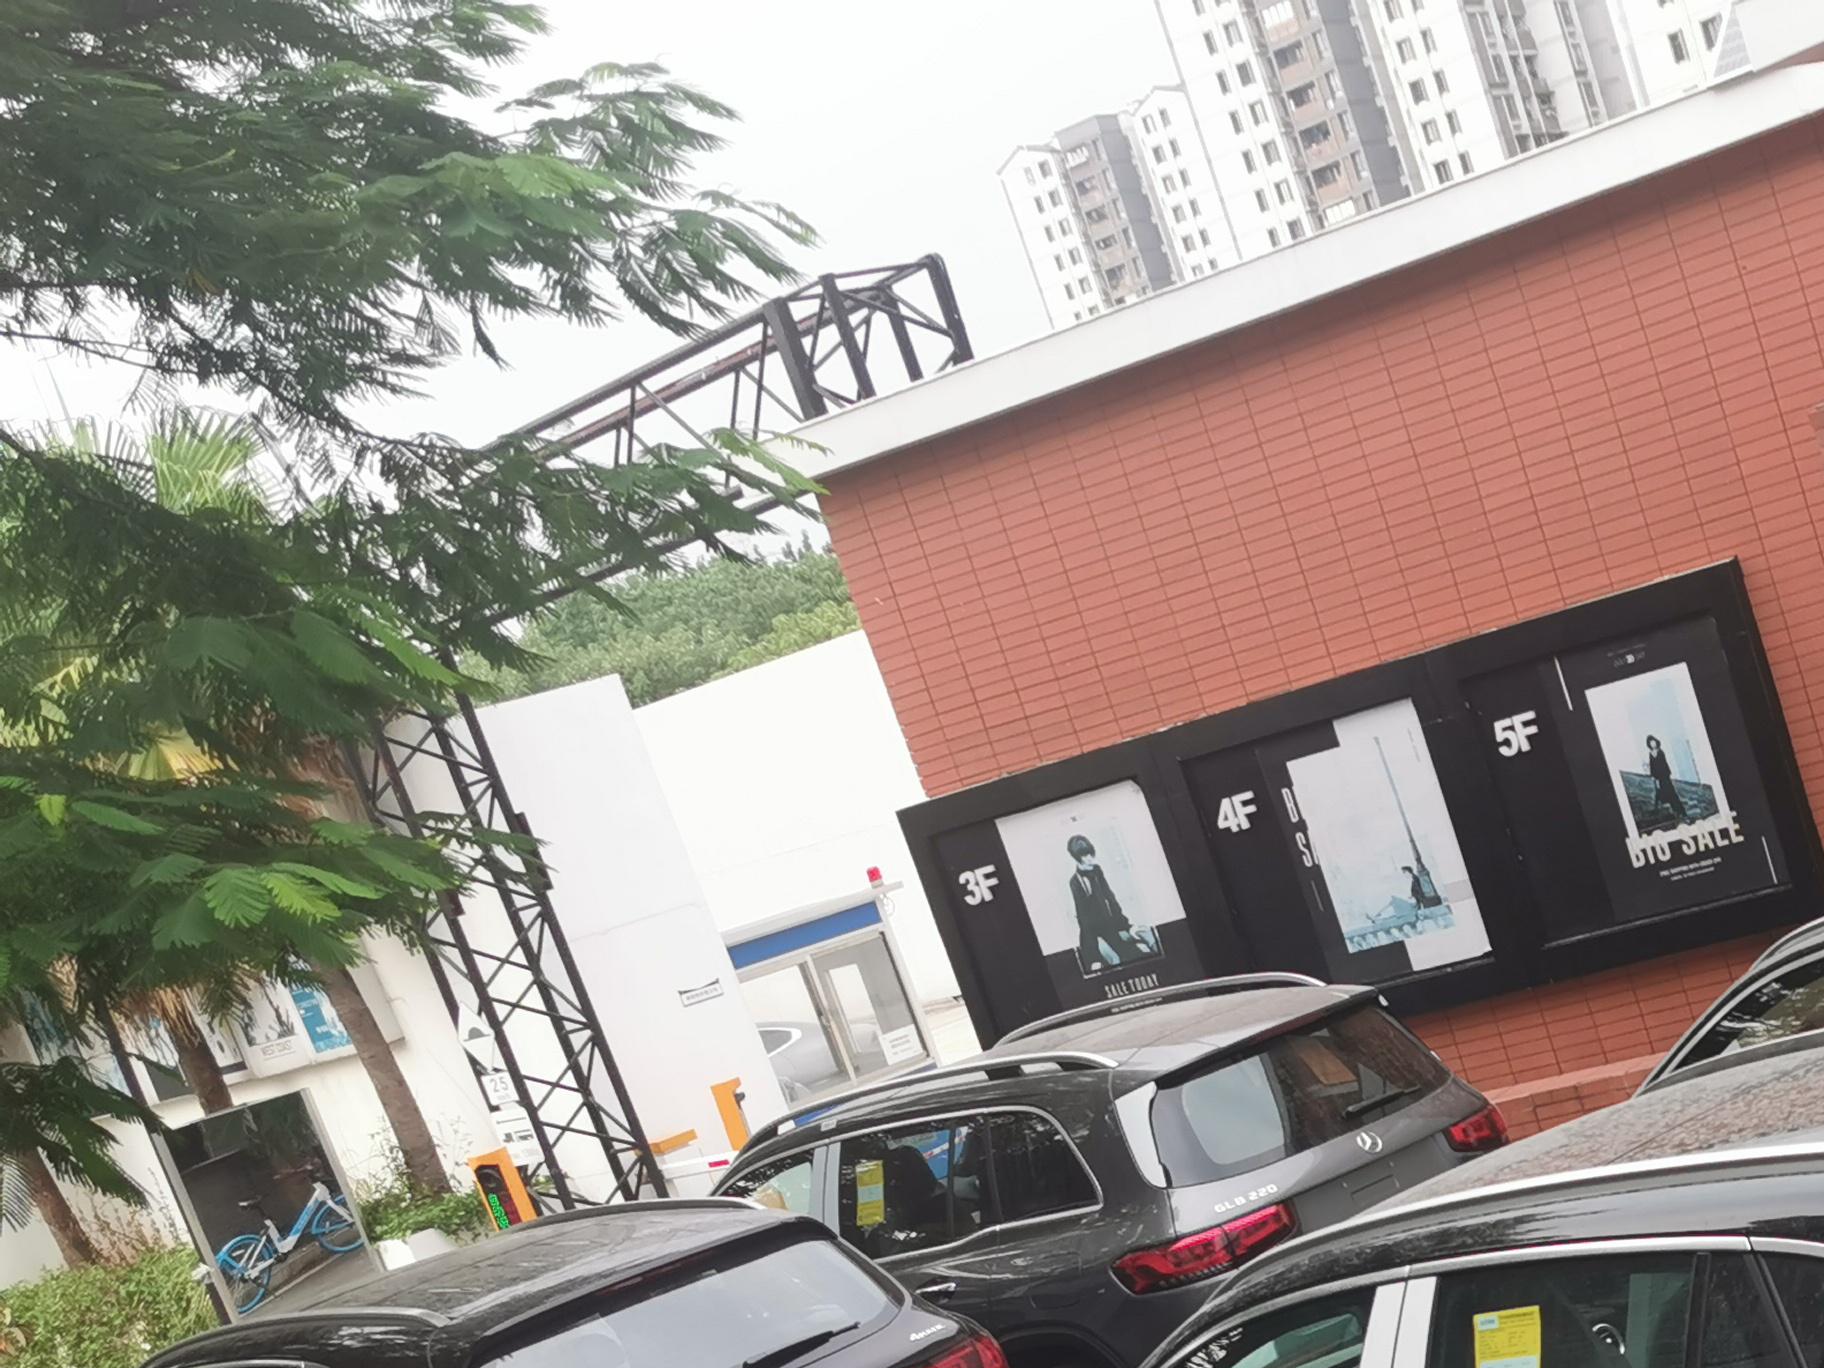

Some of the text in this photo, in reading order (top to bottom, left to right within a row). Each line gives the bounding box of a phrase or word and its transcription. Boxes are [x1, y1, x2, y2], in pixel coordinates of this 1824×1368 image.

[1493, 710, 1539, 757] 5F
[1217, 790, 1258, 833] 4F
[959, 864, 1000, 906] 3F
[1104, 973, 1159, 999] SALE TODAY
